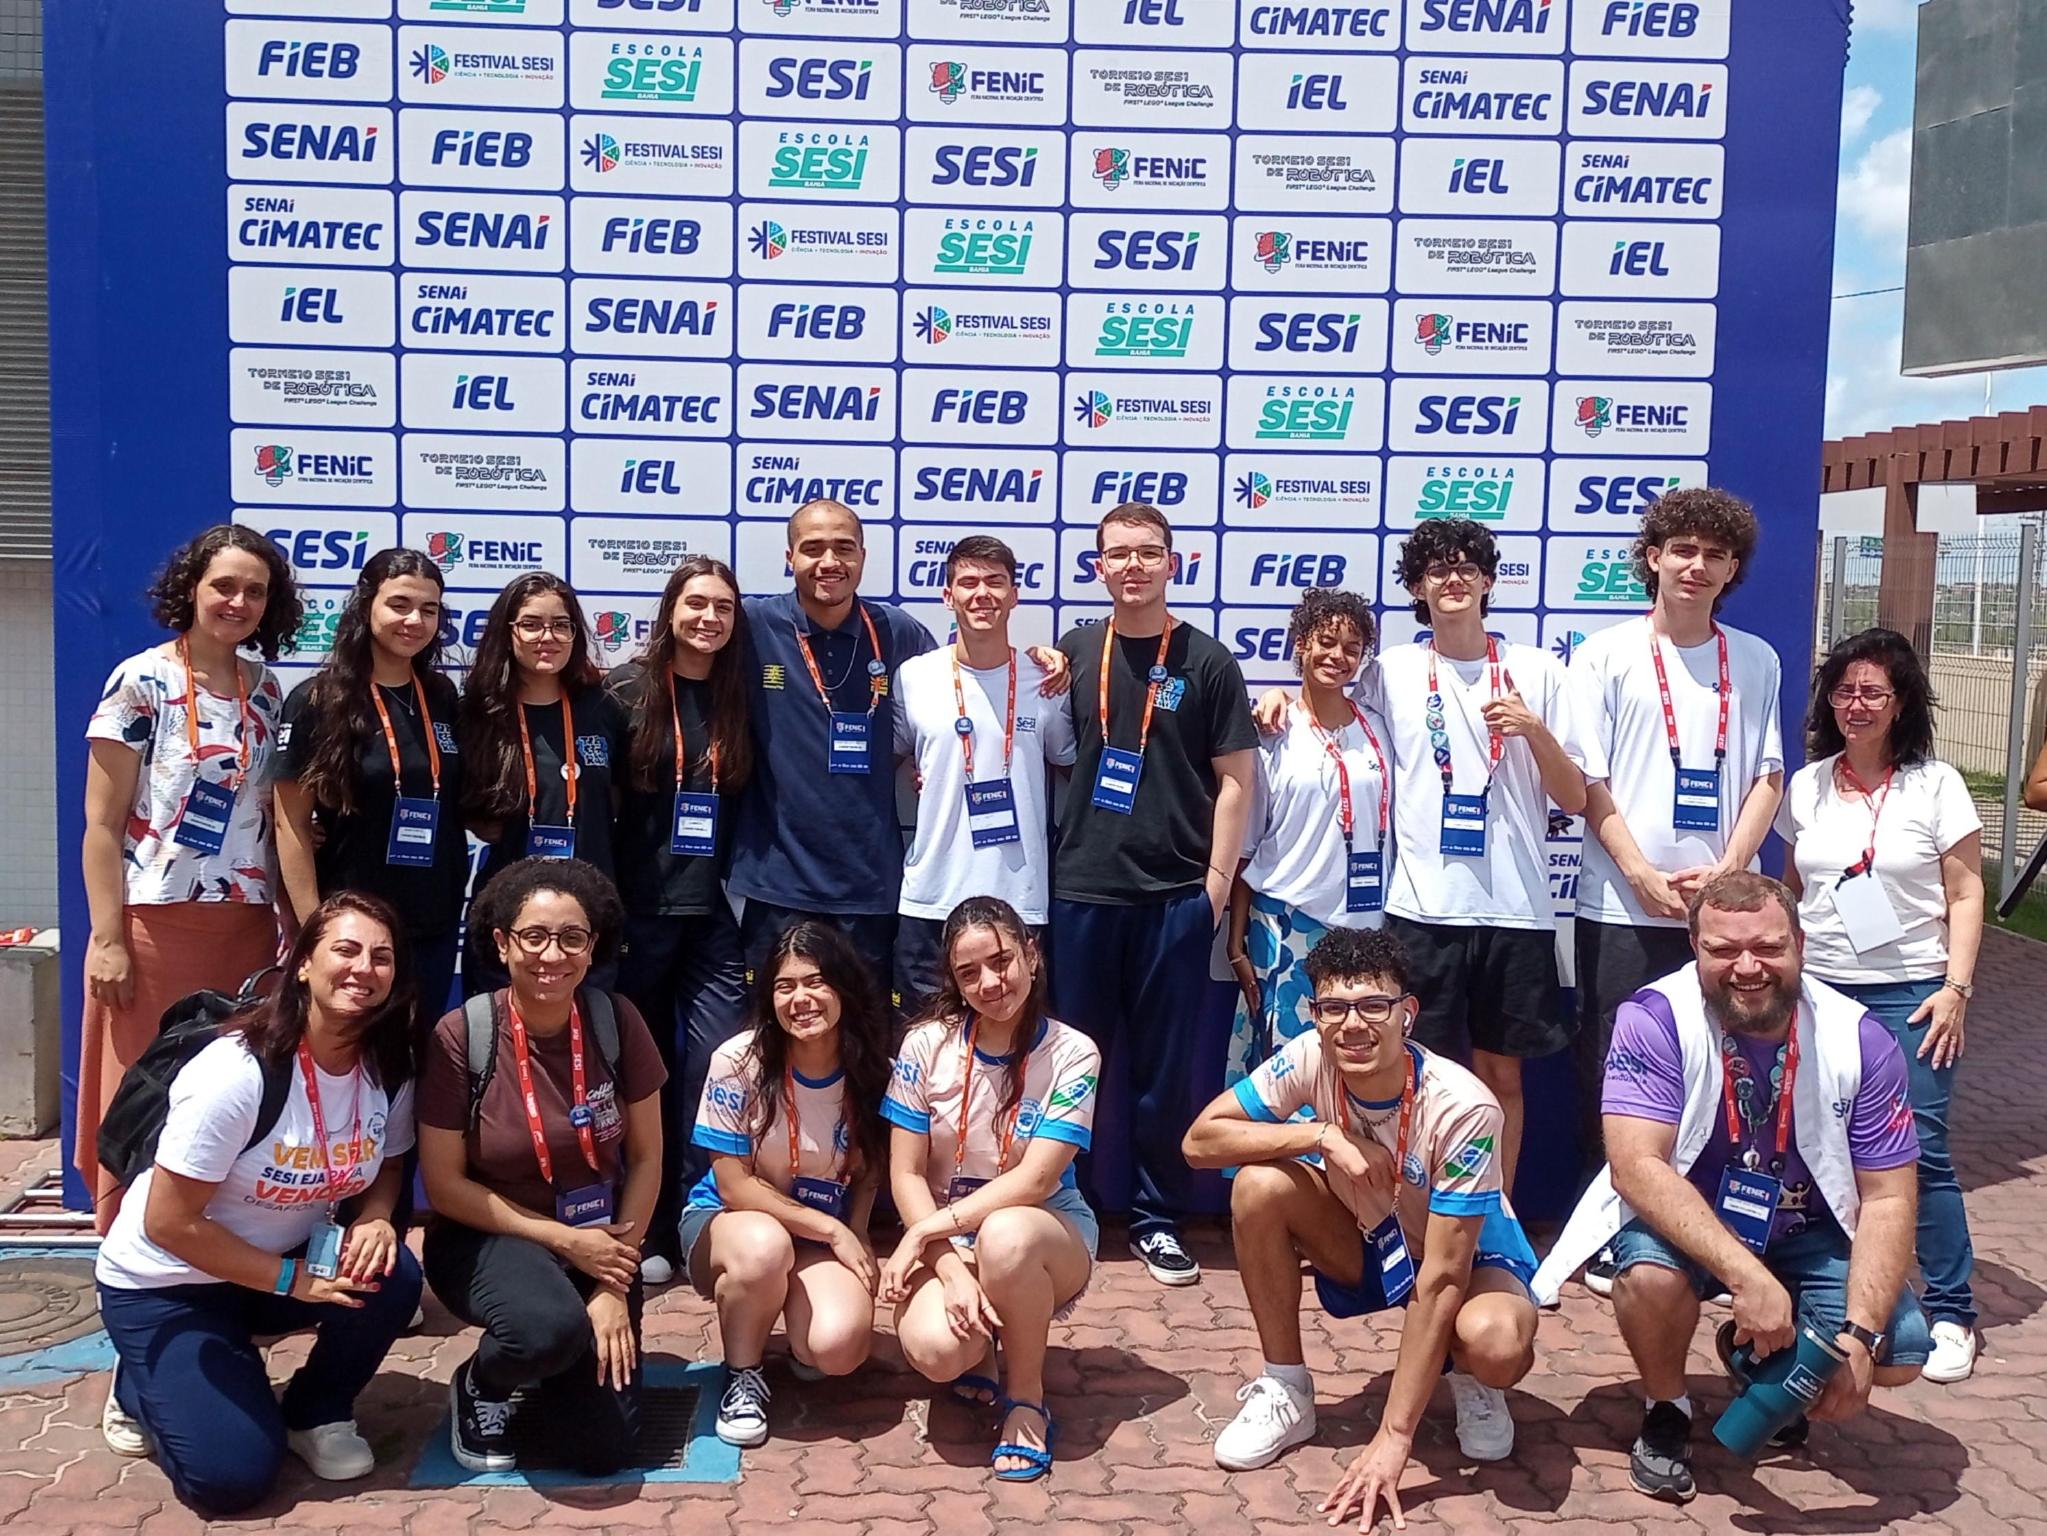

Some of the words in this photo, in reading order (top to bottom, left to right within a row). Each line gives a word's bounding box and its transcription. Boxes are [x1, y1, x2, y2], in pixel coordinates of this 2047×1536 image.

[611, 43, 702, 57] ESCOLA
[454, 53, 519, 69] FESTIVAL
[521, 56, 553, 70] SESI
[603, 57, 700, 92] SESI
[1090, 69, 1152, 80] TORNEIO
[1104, 83, 1120, 91] DE
[779, 132, 868, 146] ESCOLA
[625, 142, 689, 158] FESTIVAL
[691, 145, 723, 159] SESI
[771, 146, 867, 180] SESI
[1253, 153, 1314, 165] TORNEIO
[1267, 167, 1283, 176] DE
[944, 218, 1033, 232] ESCOLA
[791, 229, 855, 245] FESTIVAL
[857, 232, 888, 246] SESI
[1415, 236, 1476, 248] TORNEIO
[936, 231, 1031, 265] SESI
[1428, 250, 1445, 259] DE
[1106, 301, 1194, 315] ESCOLA
[955, 314, 1019, 329] FESTIVAL
[1020, 316, 1052, 330] SESI
[1576, 318, 1636, 329] TORNEIO
[1097, 315, 1192, 348] SESI
[1589, 332, 1605, 340] DE
[249, 368, 312, 379] TORNEIO
[264, 382, 281, 390] DE
[1266, 385, 1354, 398] ESCOLA
[1116, 398, 1179, 413] FESTIVAL
[1180, 400, 1211, 414] SESI
[1258, 398, 1352, 431] SESI
[421, 453, 483, 464] TORNEIO
[436, 466, 452, 475] DE
[1427, 465, 1513, 478] ESCOLA
[1276, 479, 1338, 493] FESTIVAL
[1340, 481, 1370, 494] SESI
[1418, 479, 1512, 511] SESI
[915, 540, 955, 554] SENA
[1499, 562, 1529, 577] SESI
[1548, 853, 1582, 867] SEN
[273, 1142, 328, 1170] VEM
[261, 1166, 297, 1185] SESI
[300, 1173, 326, 1185] EJA
